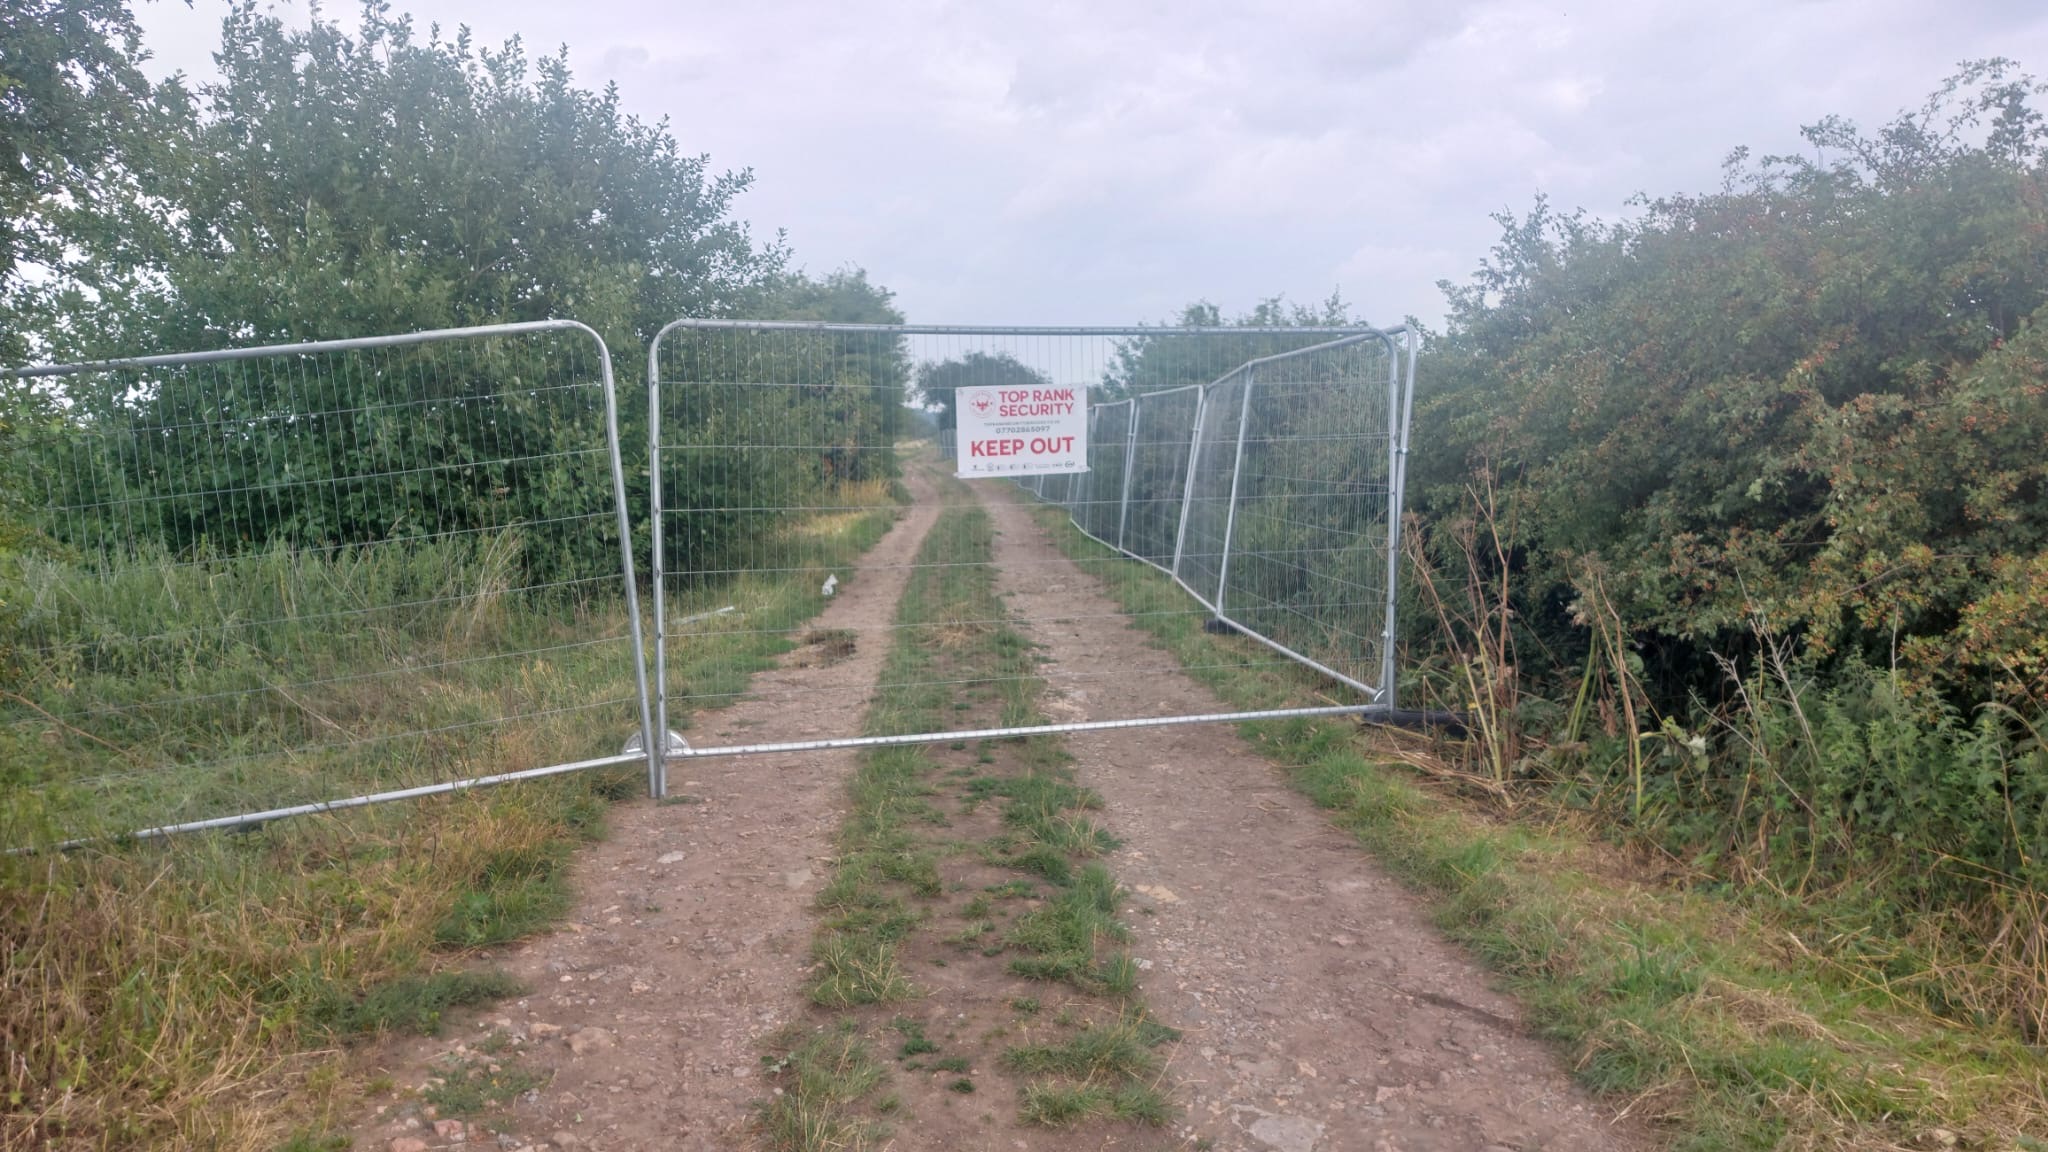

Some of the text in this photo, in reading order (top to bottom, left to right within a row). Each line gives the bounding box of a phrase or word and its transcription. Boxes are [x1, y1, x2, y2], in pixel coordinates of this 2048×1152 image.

[998, 388, 1075, 403] TOP RANK
[999, 402, 1074, 417] SECURITY
[971, 436, 1075, 457] KEEP OUT
